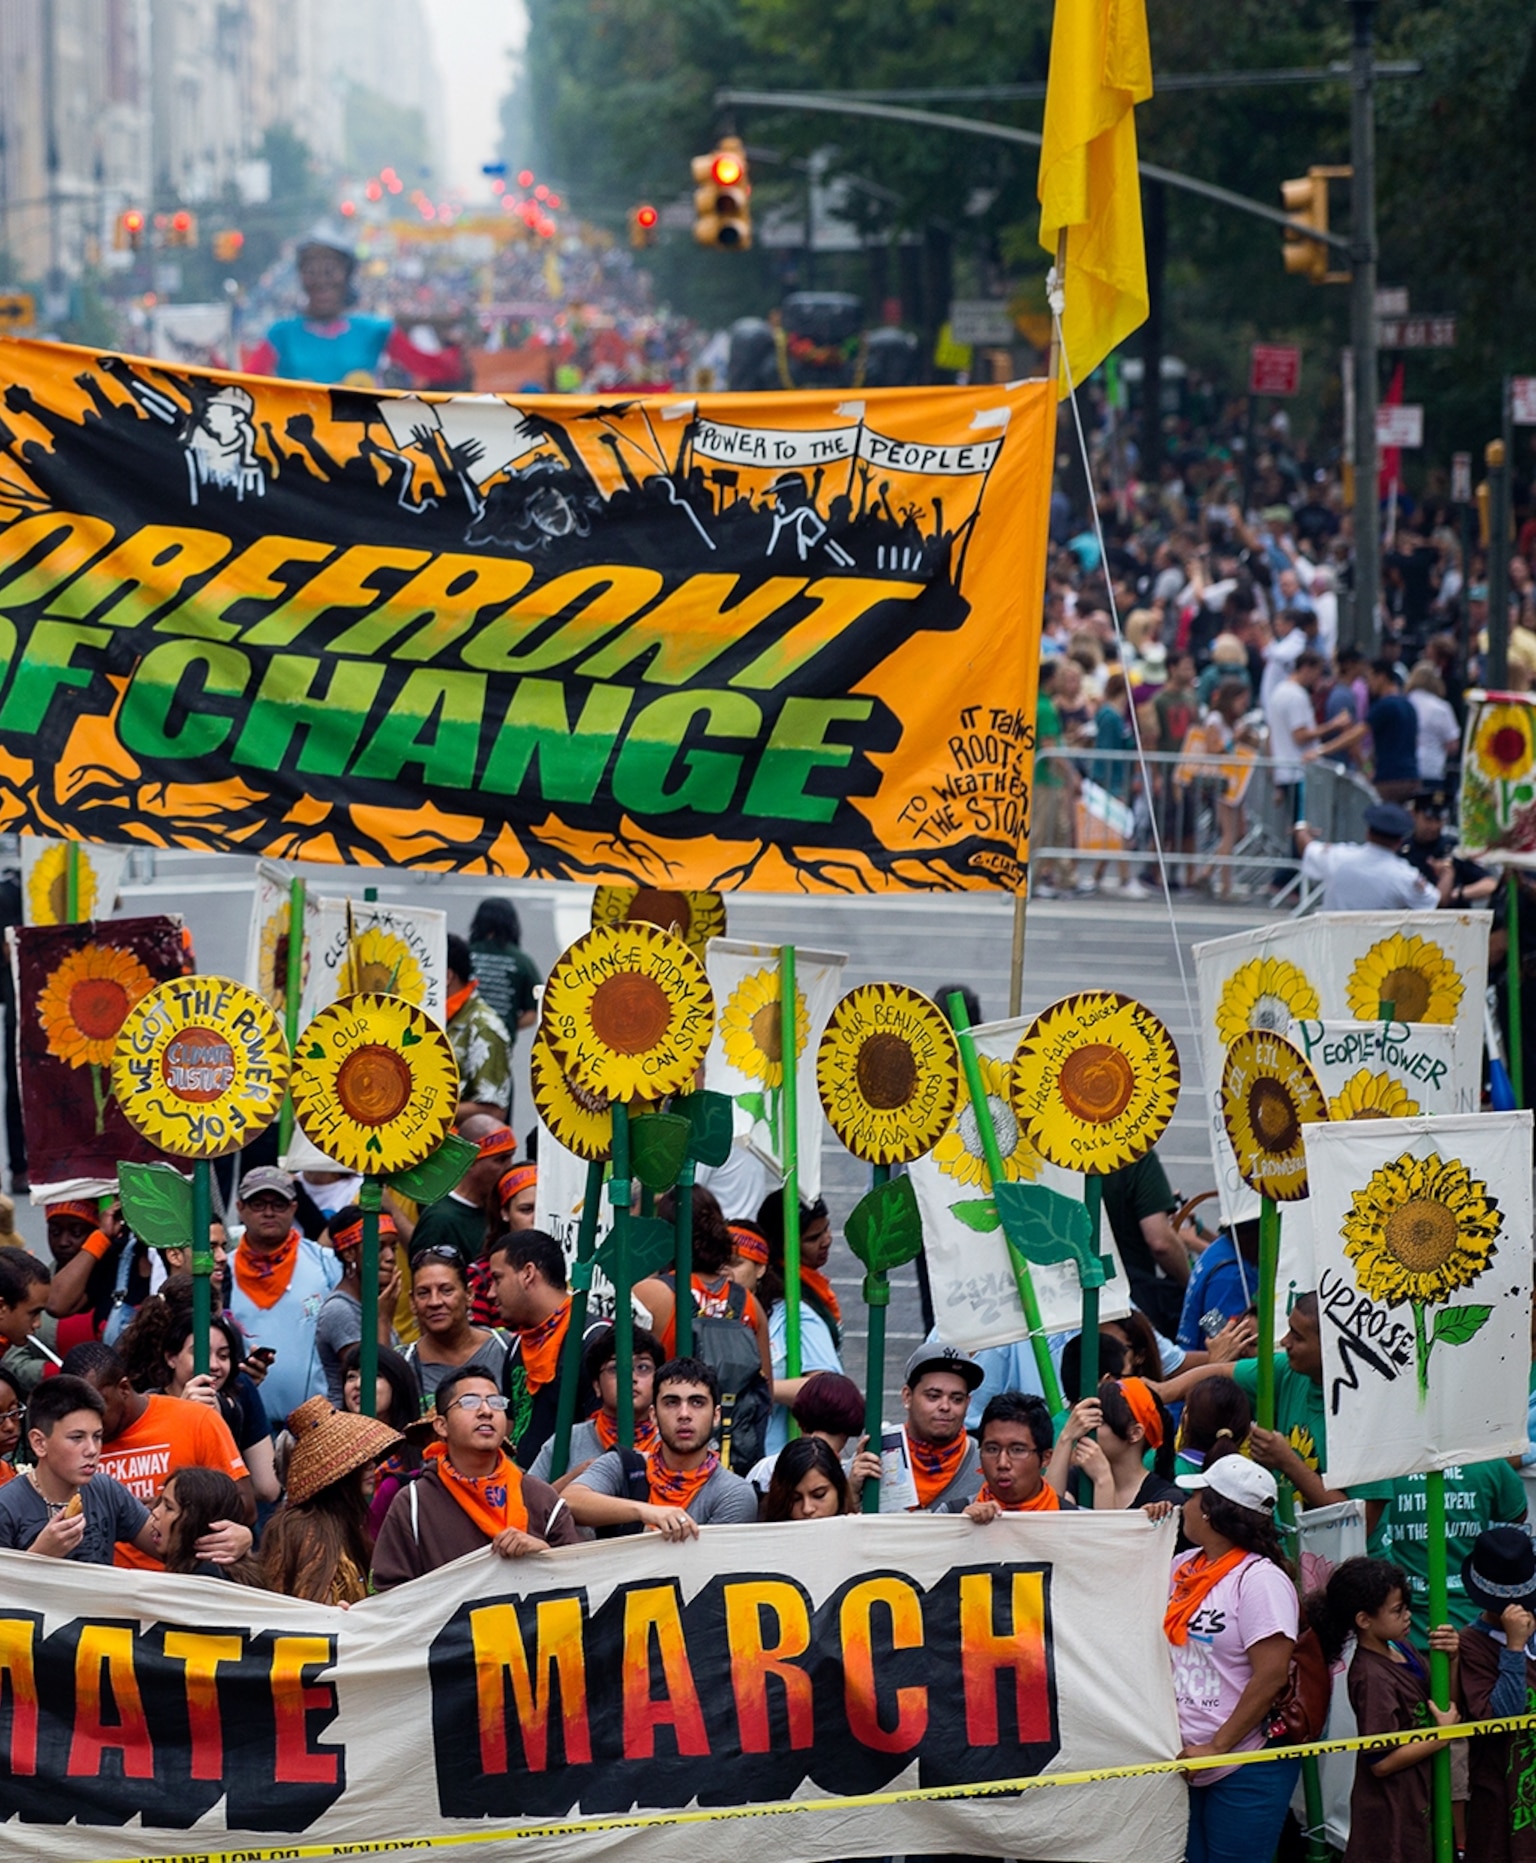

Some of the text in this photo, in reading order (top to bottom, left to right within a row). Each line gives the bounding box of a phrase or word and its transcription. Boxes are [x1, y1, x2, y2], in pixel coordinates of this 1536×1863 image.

[701, 427, 990, 469] POWER TO THE PEOPLE!
[117, 638, 872, 824] CHANGE
[960, 705, 983, 729] IT
[897, 795, 928, 823] TO
[912, 804, 963, 843] THE
[564, 946, 642, 990] CHANGE
[650, 952, 696, 1002] TODAY
[332, 1017, 371, 1048] OUR
[559, 1004, 706, 1077] SO WE CAN STAY
[841, 1011, 872, 1044] OUR
[129, 990, 273, 1143] WE GOT THE POWER FOR
[167, 1042, 233, 1065] CLIMATE
[833, 1049, 850, 1072] AT
[167, 1066, 235, 1091] JUSTICE
[301, 1070, 342, 1135] HELP
[401, 1085, 438, 1140] EARTH
[832, 1077, 855, 1125] LOOK
[909, 1074, 942, 1128] ROOTS
[96, 1452, 171, 1480] OCKAWAY
[1444, 1492, 1477, 1510] XPERT
[467, 1569, 1054, 1778] MARCH
